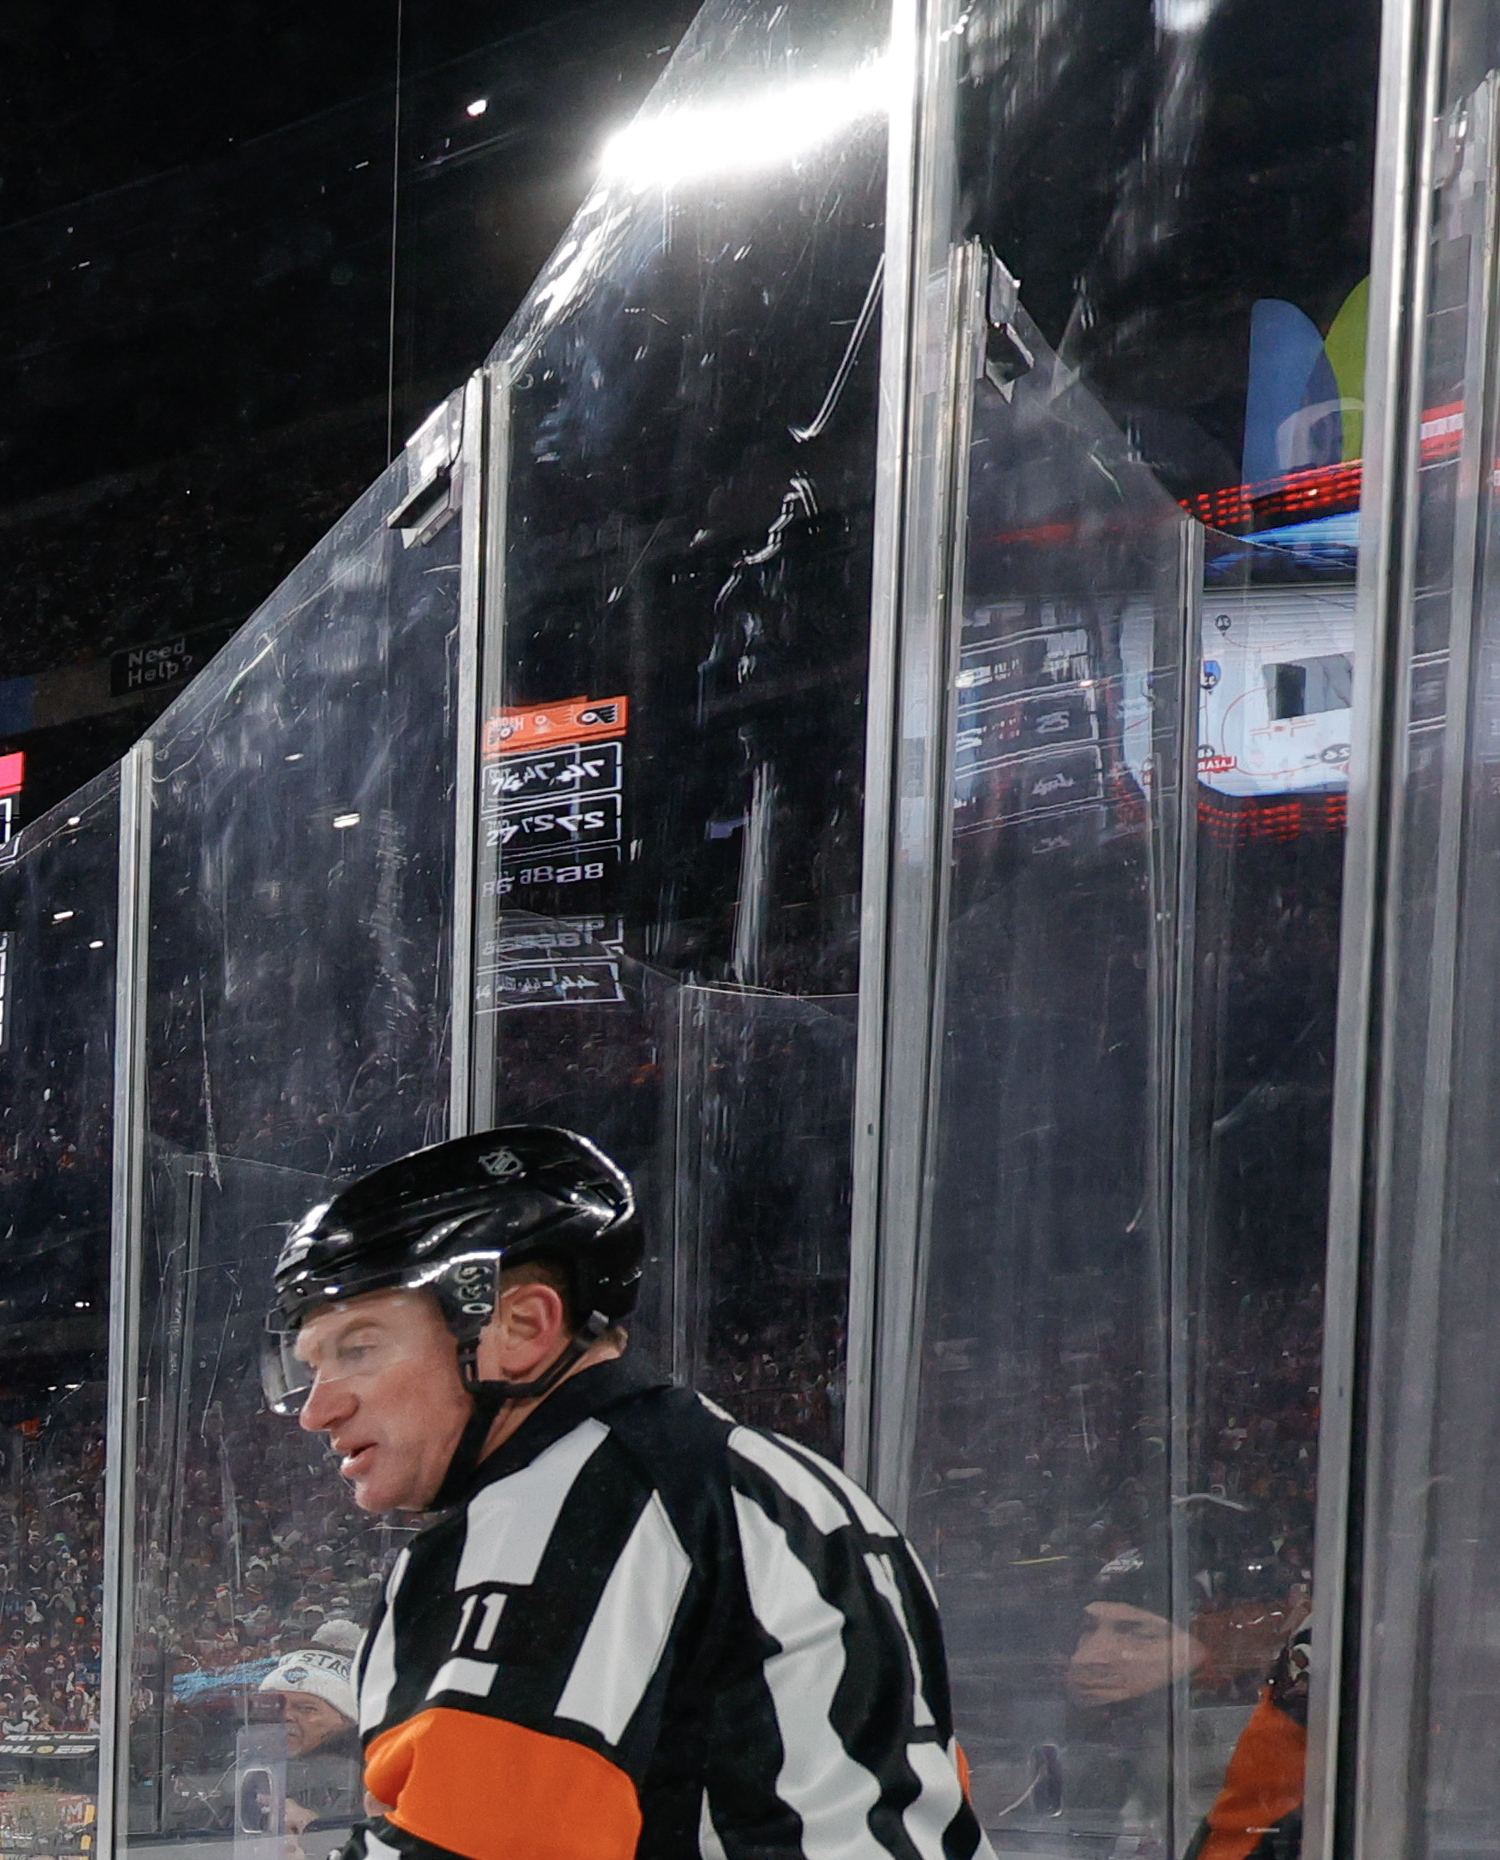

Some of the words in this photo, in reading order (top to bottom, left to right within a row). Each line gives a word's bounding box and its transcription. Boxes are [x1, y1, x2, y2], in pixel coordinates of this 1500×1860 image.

[128, 637, 186, 668] Need
[128, 655, 193, 688] Help?
[450, 1591, 509, 1653] 11
